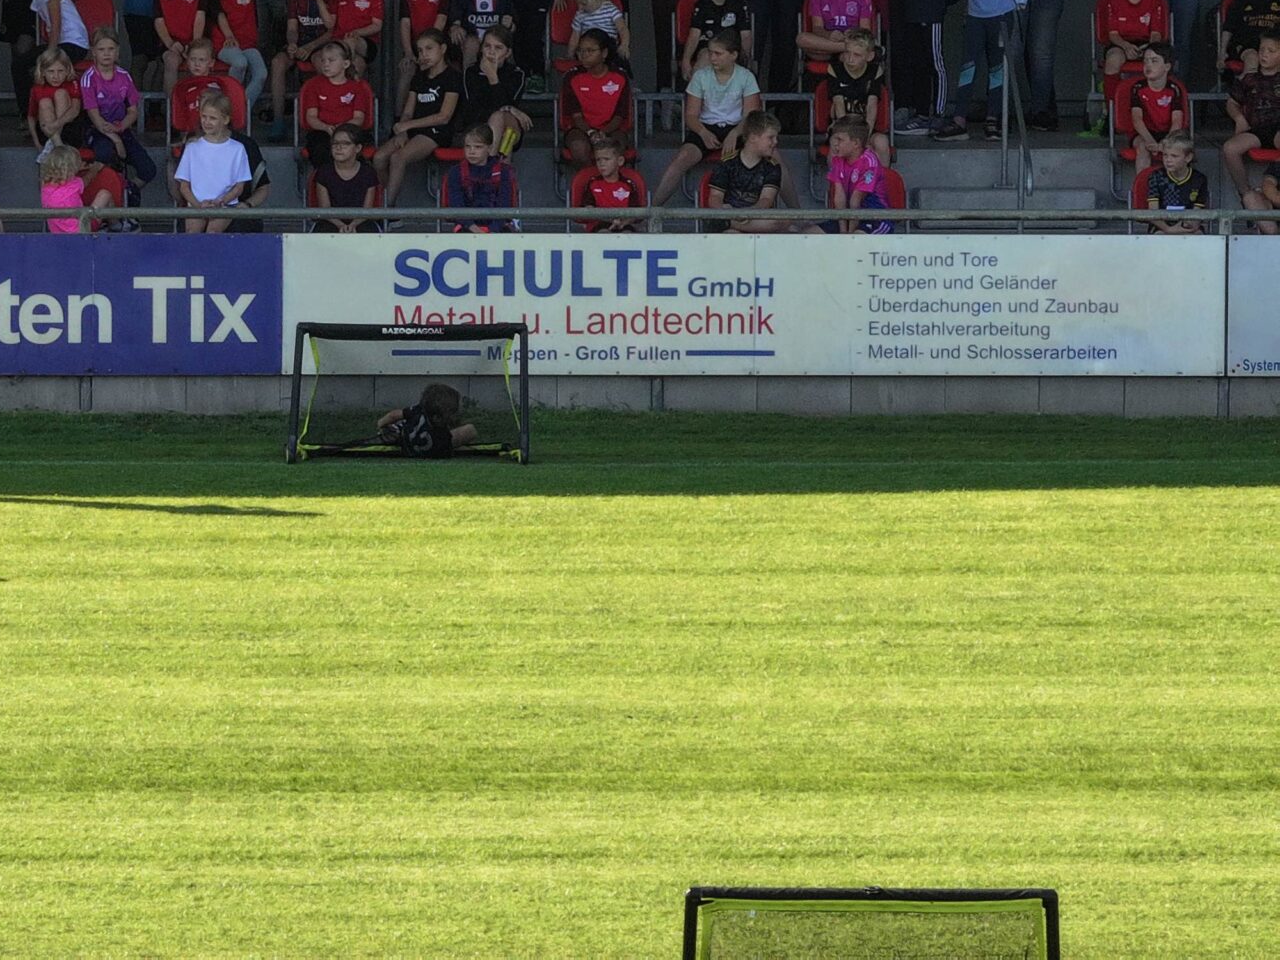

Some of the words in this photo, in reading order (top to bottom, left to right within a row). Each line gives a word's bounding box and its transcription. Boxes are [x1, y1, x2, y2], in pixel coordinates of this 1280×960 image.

[467, 14, 500, 24] QATAR
[869, 250, 918, 267] Türen
[923, 252, 954, 267] und
[960, 252, 999, 267] Tore
[394, 248, 678, 298] SCHULTE
[687, 277, 775, 298] GmbH
[868, 275, 937, 294] Treppen
[943, 275, 974, 290] und
[980, 274, 1057, 291] Geländer
[133, 275, 258, 343] Tix
[868, 295, 1002, 317] Überdachungen
[1008, 298, 1039, 313] und
[1045, 298, 1119, 314] Zaunbau
[566, 305, 775, 335] Landtechnik
[868, 320, 1051, 340] Edelstahlverarbeitung
[575, 345, 621, 361] Groß
[626, 345, 681, 360] Fullen
[868, 344, 924, 359] Metall-
[930, 344, 961, 359] und
[967, 343, 1117, 360] Schlosserarbeiten
